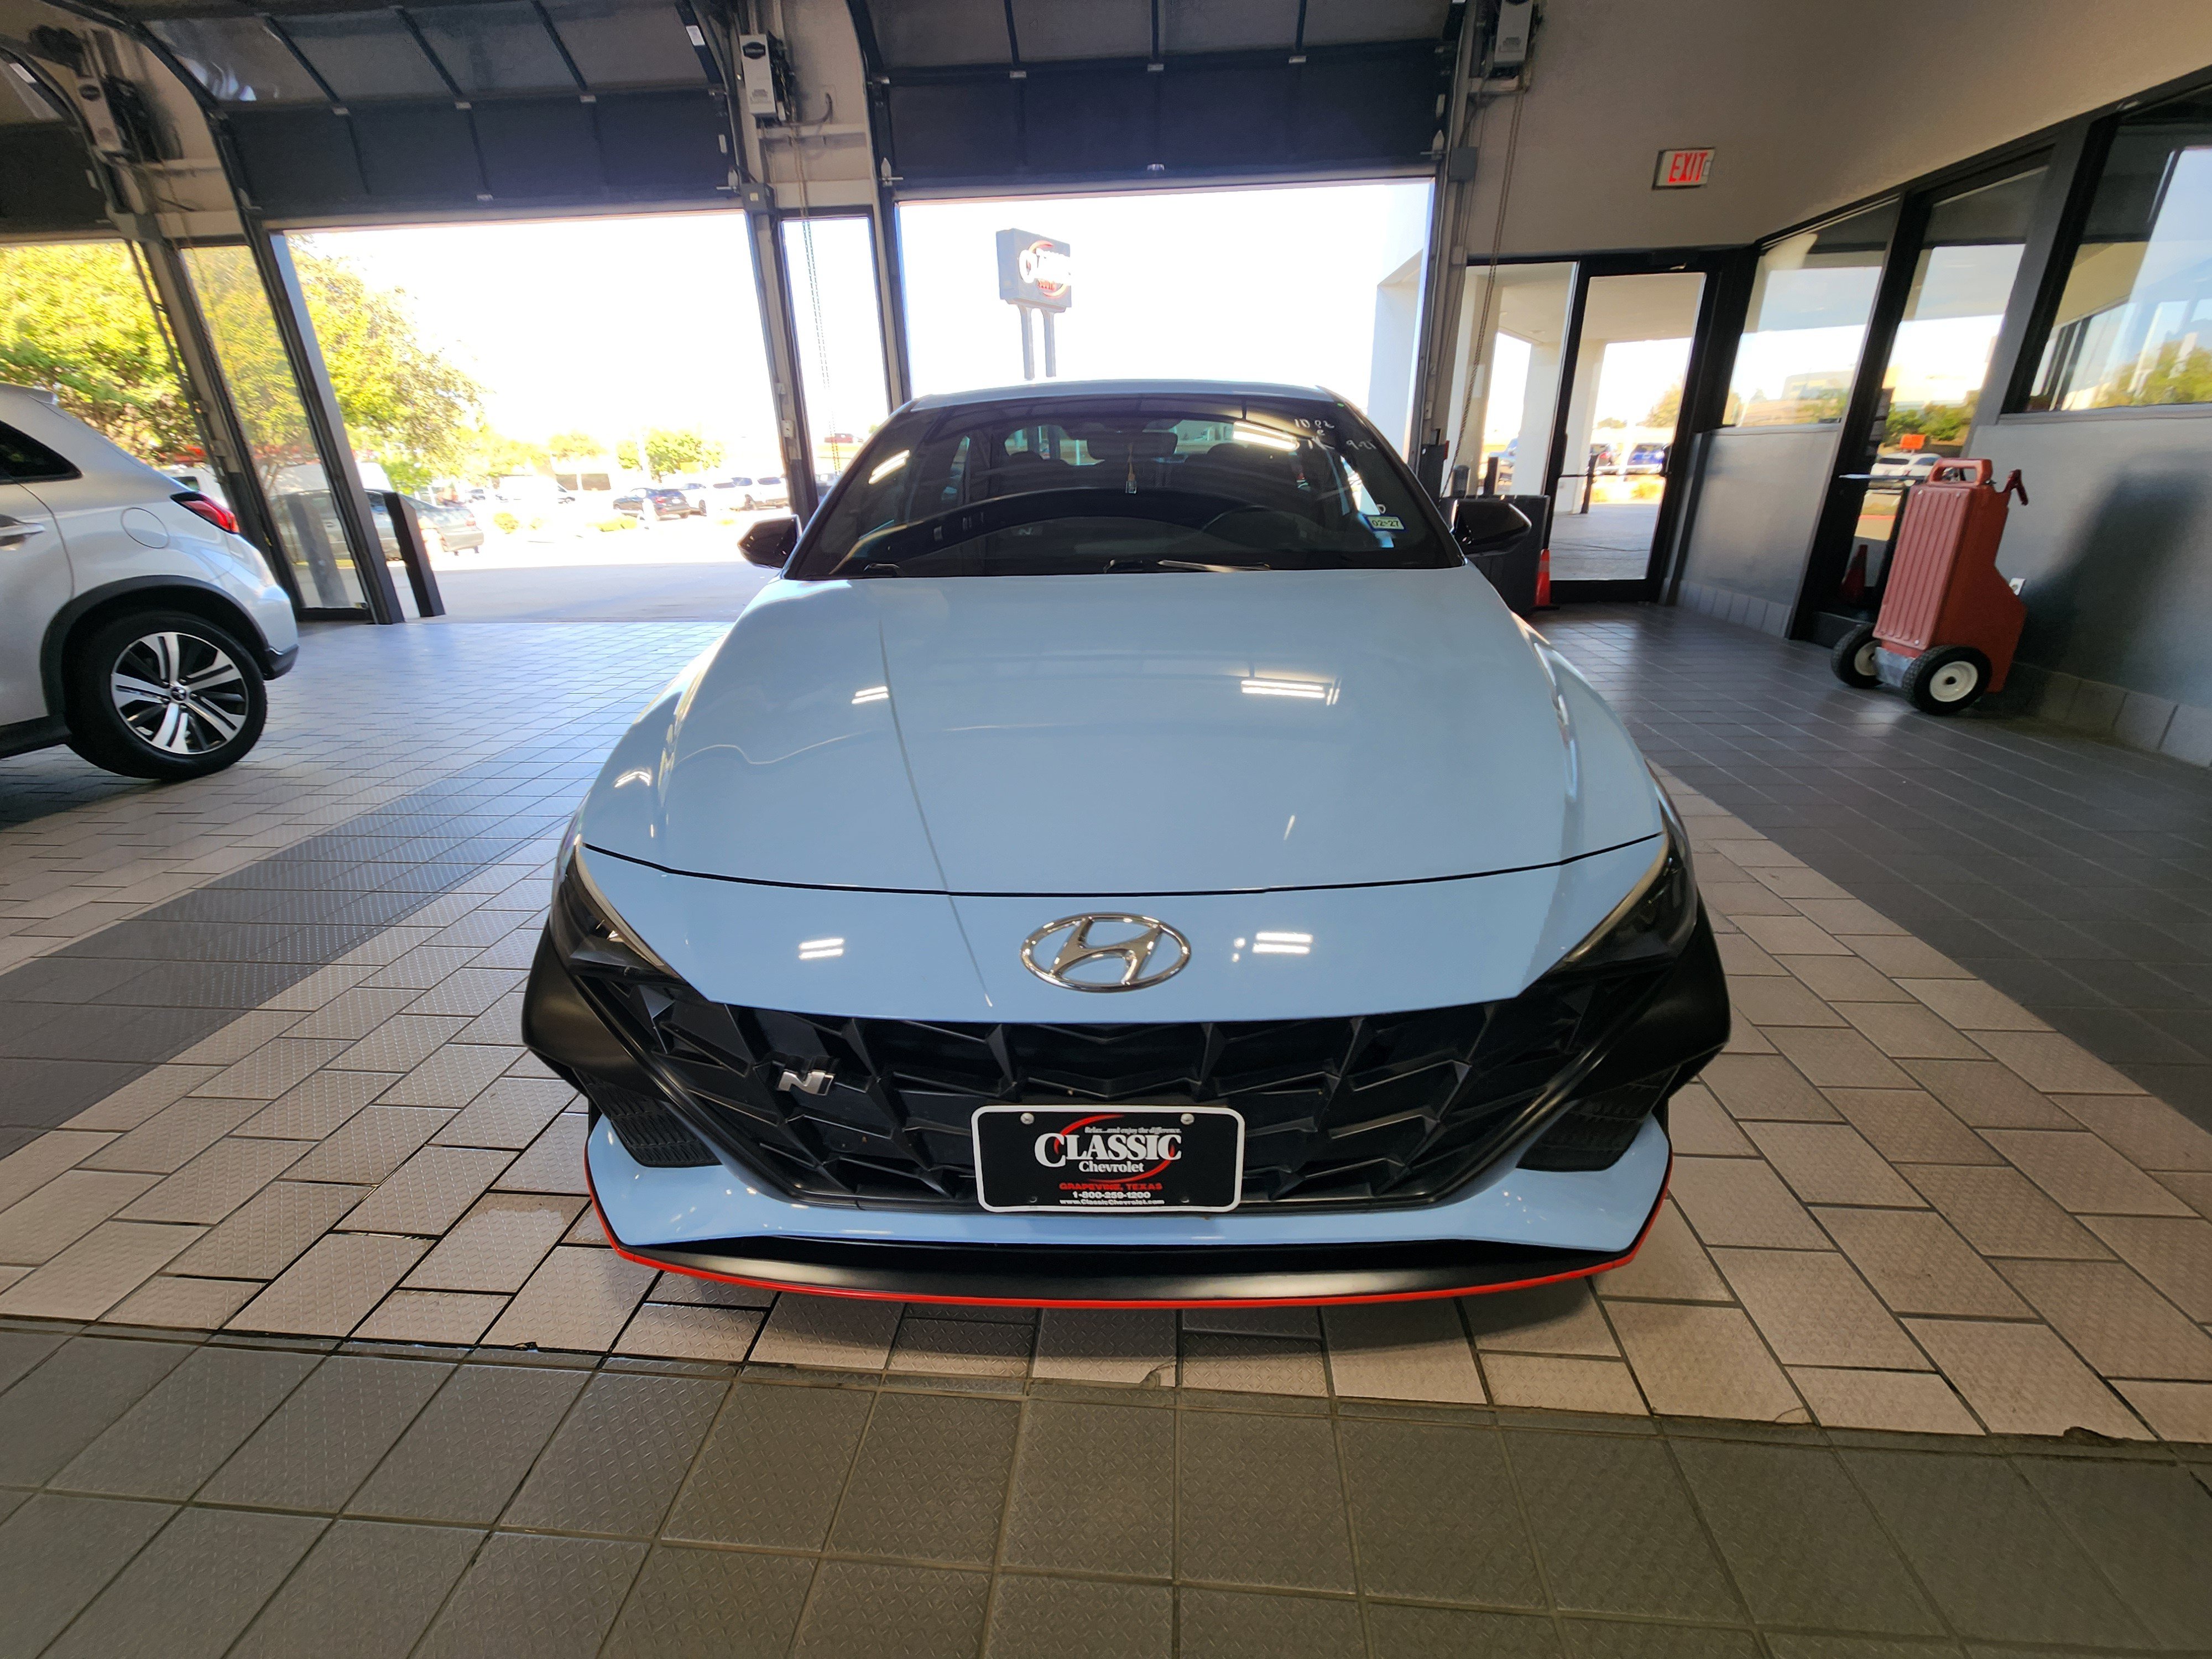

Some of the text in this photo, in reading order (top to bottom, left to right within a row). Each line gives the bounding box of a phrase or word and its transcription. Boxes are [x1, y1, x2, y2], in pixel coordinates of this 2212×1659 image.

[1668, 151, 1708, 182] EXIT
[1035, 1133, 1182, 1167] CLASSIC
[1079, 1161, 1144, 1172] Chevrolet
[1125, 1182, 1163, 1191] TEXAS
